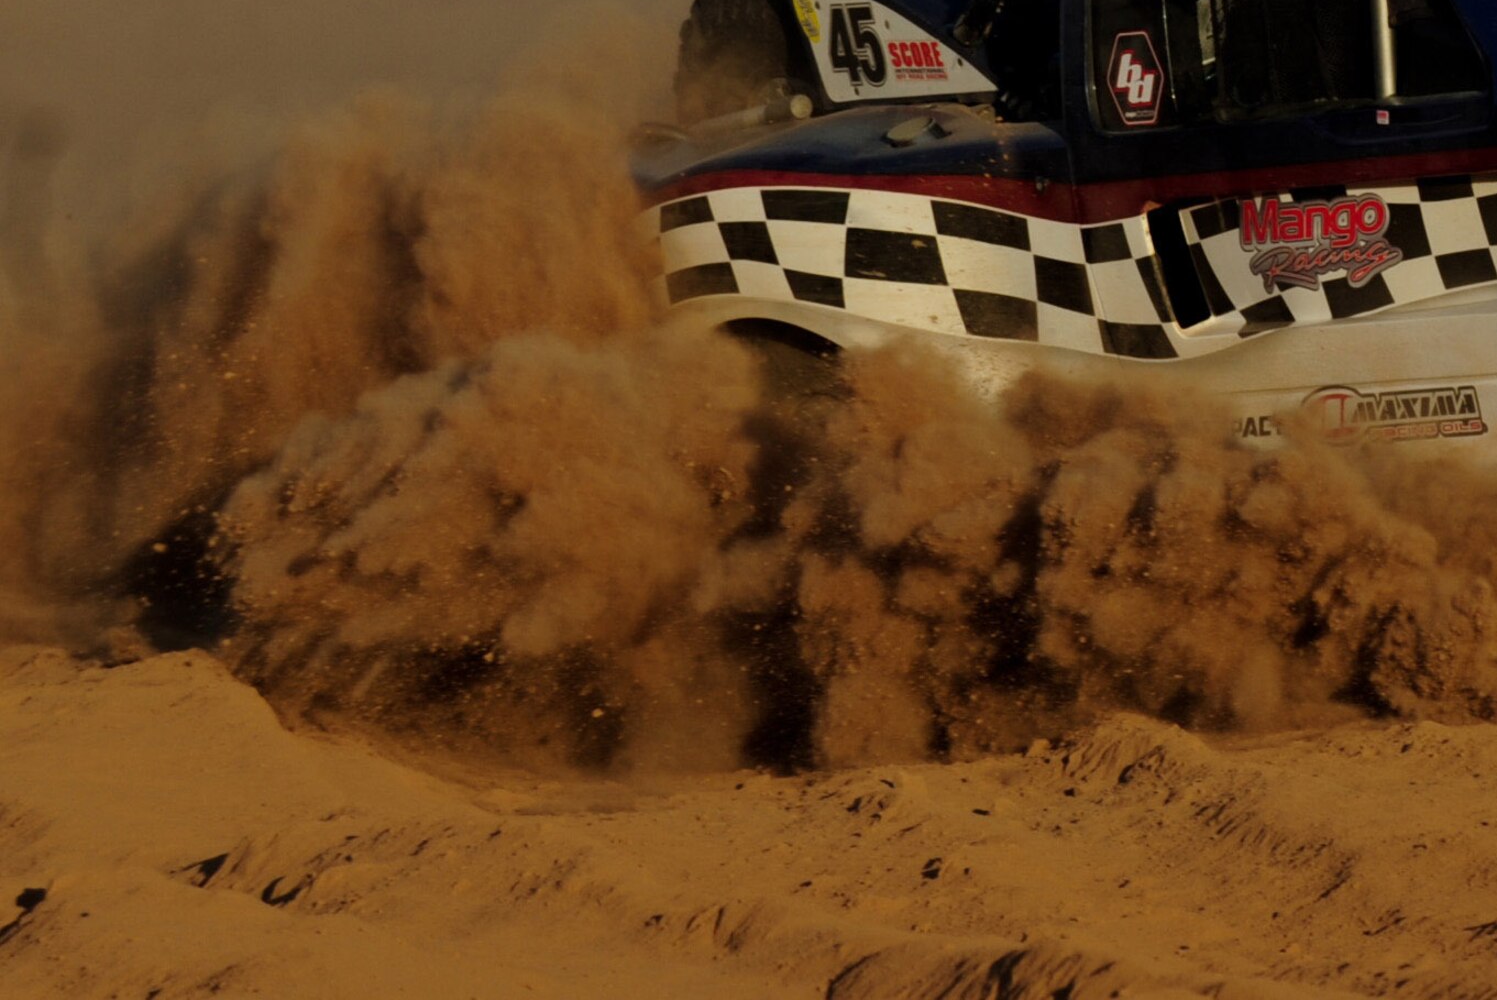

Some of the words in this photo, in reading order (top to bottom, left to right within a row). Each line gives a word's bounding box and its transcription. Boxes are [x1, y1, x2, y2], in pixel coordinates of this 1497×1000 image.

[829, 2, 887, 87] 45
[888, 41, 944, 67] SCORE
[1241, 198, 1386, 249] Mango
[1350, 393, 1477, 423] MAXIMA
[1442, 421, 1482, 434] OILS
